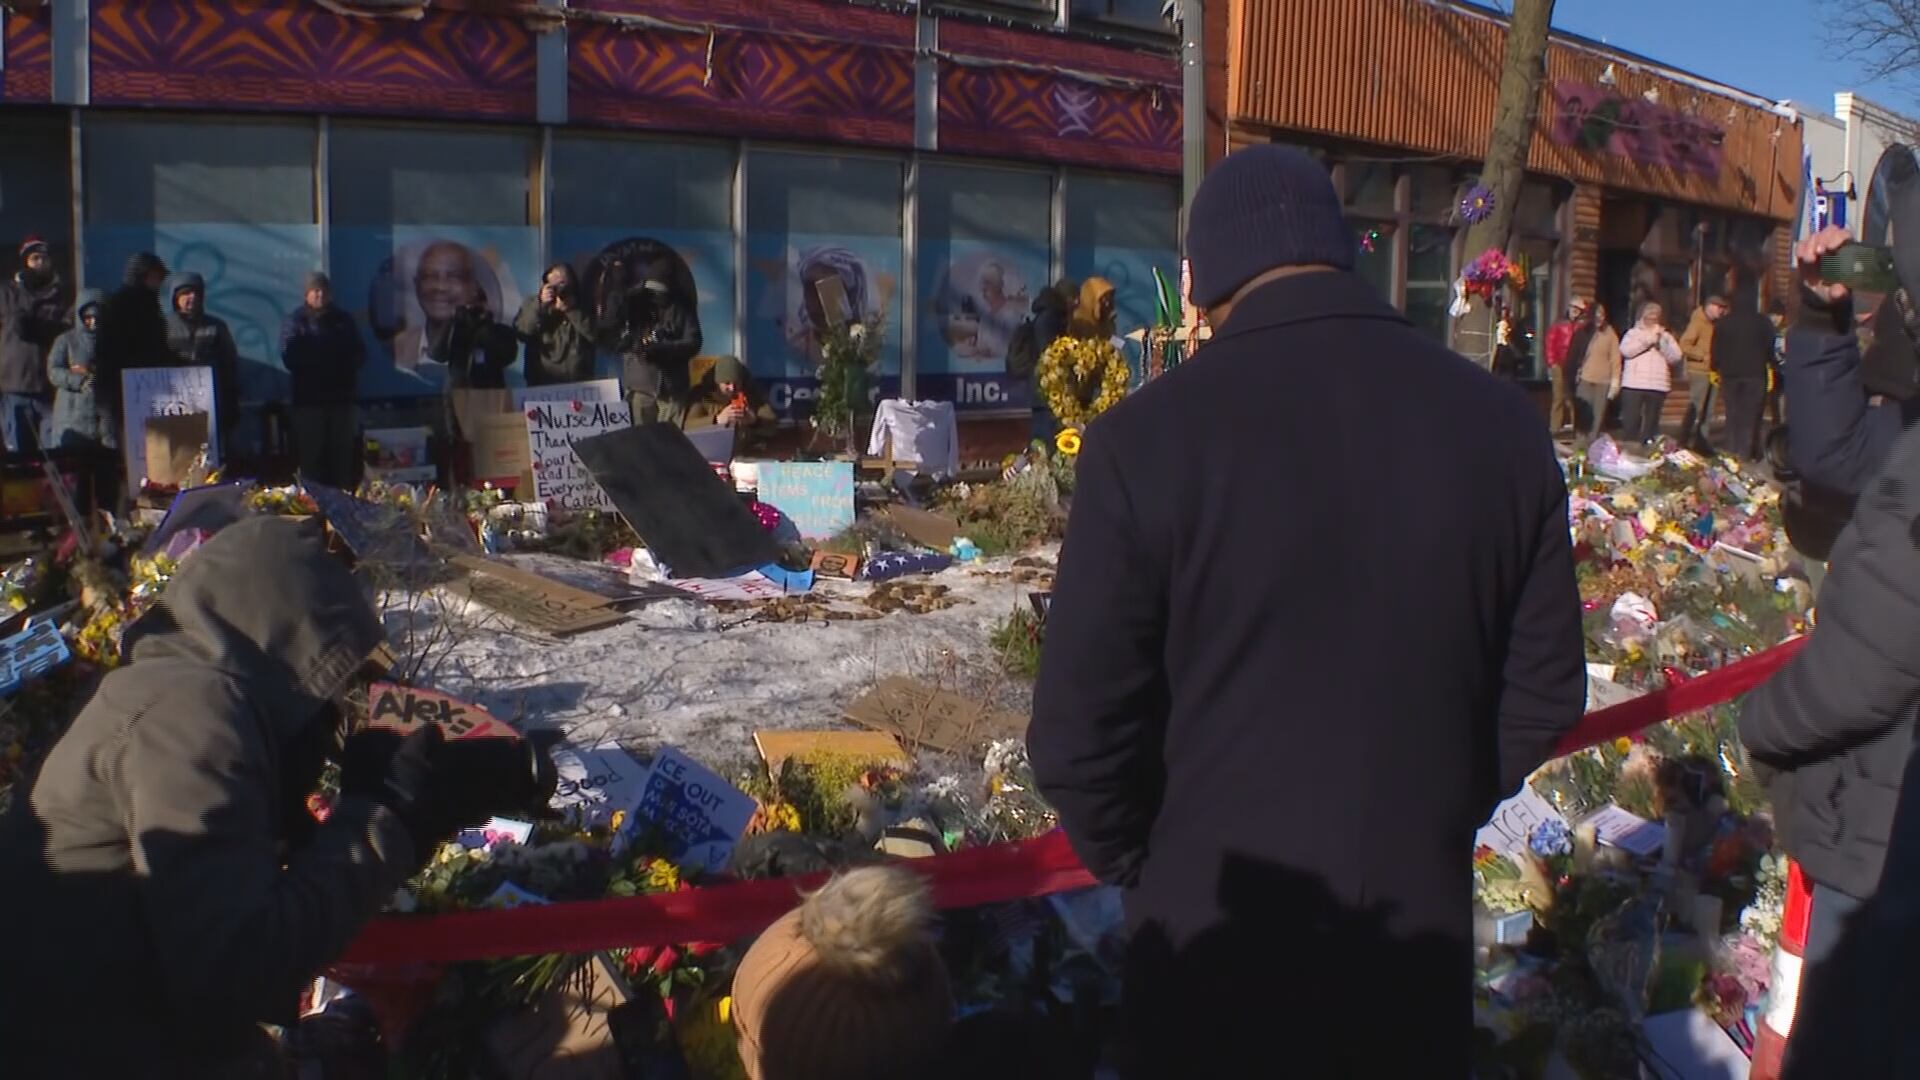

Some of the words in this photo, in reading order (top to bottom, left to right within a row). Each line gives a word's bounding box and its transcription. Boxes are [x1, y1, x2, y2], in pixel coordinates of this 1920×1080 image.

[956, 377, 1008, 402] Inc.
[536, 404, 590, 429] Nurse
[591, 403, 630, 427] Alex
[781, 464, 833, 479] PEACE
[657, 755, 687, 781] ICE
[687, 783, 725, 812] OUT
